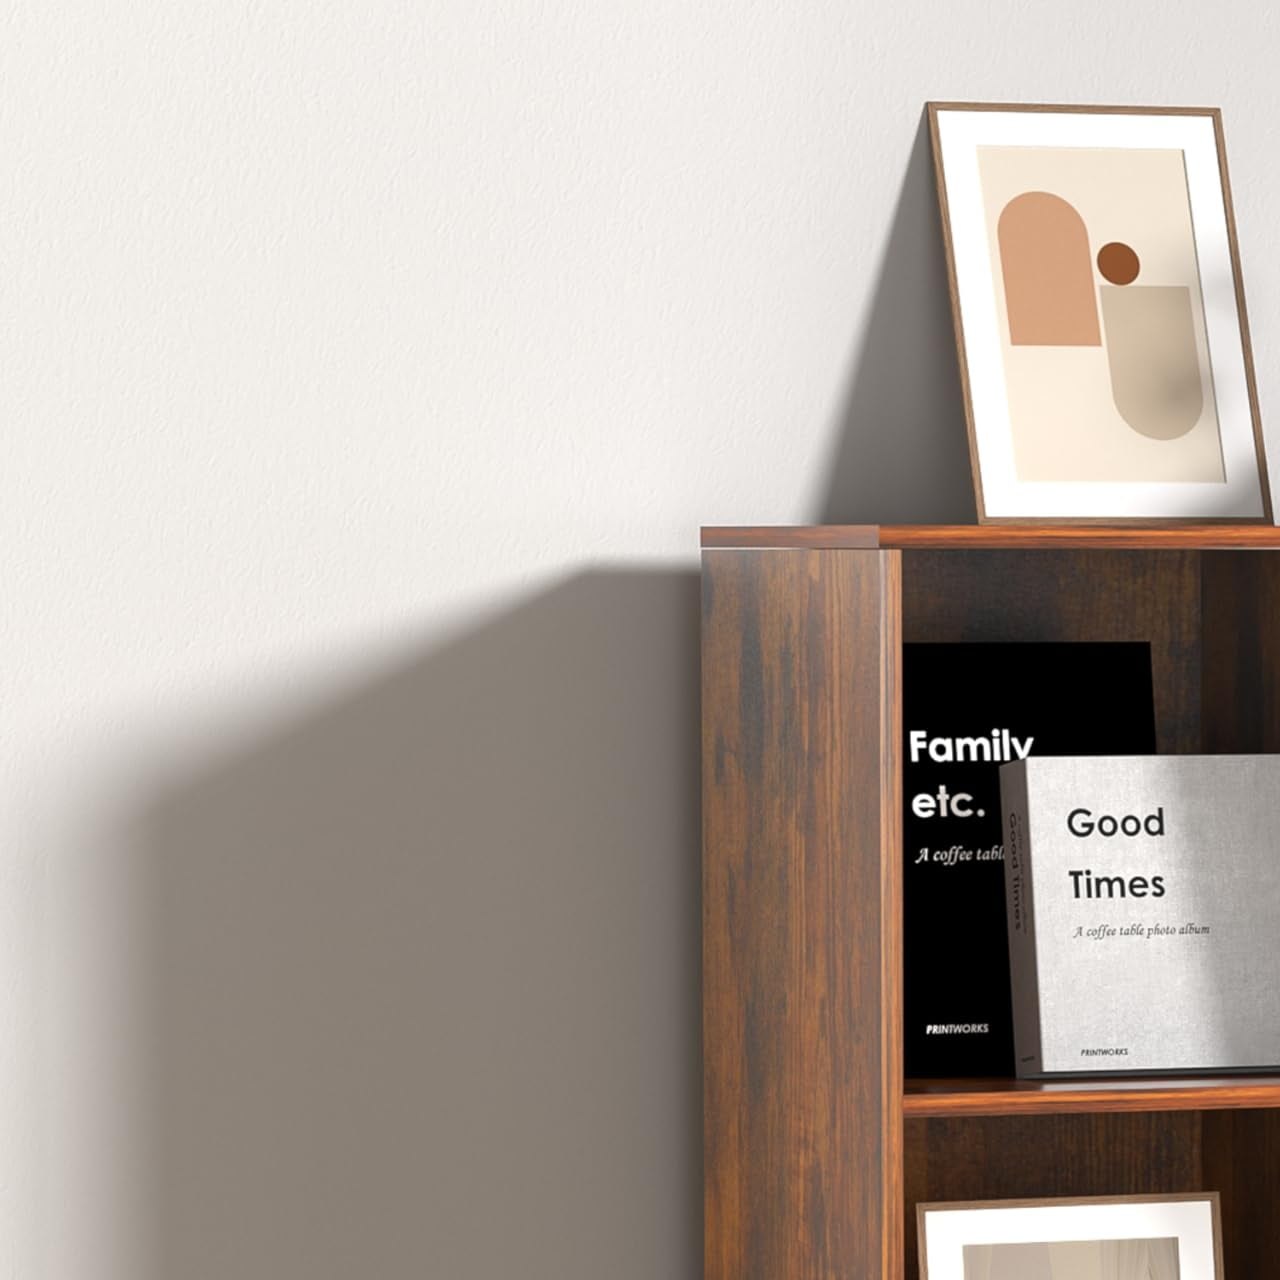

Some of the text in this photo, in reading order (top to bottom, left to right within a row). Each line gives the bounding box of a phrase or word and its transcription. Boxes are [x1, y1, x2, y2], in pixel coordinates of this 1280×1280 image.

[909, 728, 1034, 763] Family
[911, 784, 986, 818] etc.
[1067, 807, 1165, 837] Good
[914, 845, 1006, 866] A coffee tabl
[1009, 812, 1021, 931] Good Times
[1068, 870, 1165, 899] Times
[1073, 922, 1211, 941] A coffee table photo album
[926, 1023, 989, 1035] PRINTWORKS
[1080, 1048, 1129, 1057] PRINTWORKS
